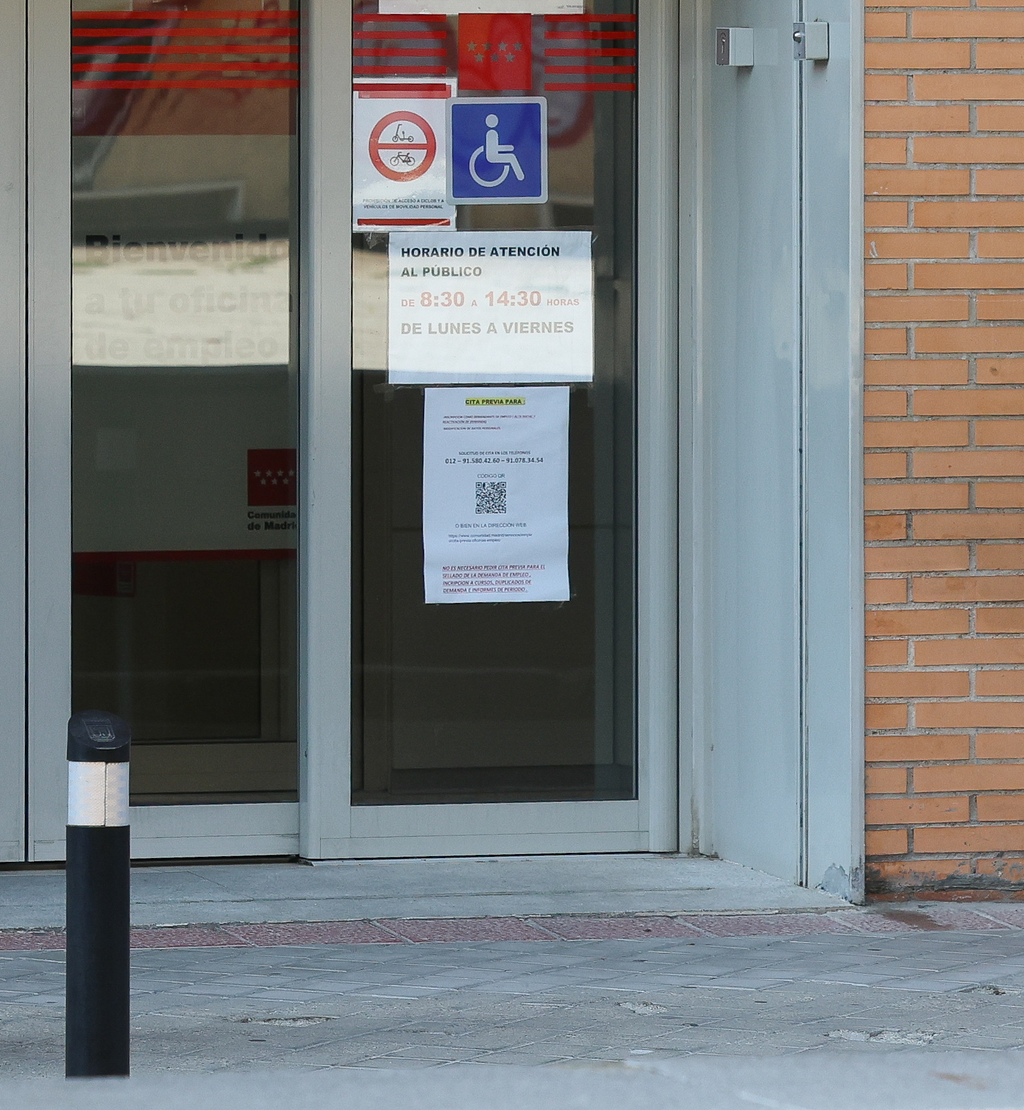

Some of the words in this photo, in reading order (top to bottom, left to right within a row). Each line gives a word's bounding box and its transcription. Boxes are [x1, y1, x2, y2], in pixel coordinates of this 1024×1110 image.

[400, 247, 464, 258] HORARIO
[468, 246, 486, 257] DE
[489, 244, 560, 257] ATENCIÓN
[400, 267, 418, 277] AL
[422, 264, 482, 277] PÚBLICO
[85, 292, 105, 315] a
[401, 299, 415, 307] DE
[420, 291, 465, 307] 8:30
[471, 299, 477, 307] A
[485, 290, 542, 307] 14:30
[546, 298, 580, 306] HORAS
[400, 322, 422, 335] DE
[428, 322, 482, 334] LUNES
[486, 322, 498, 334] A
[503, 321, 574, 334] VIERNES
[85, 332, 130, 361] de
[143, 331, 279, 365] empleo
[247, 510, 296, 519] Comunida
[247, 521, 261, 530] de
[264, 521, 297, 530] Madri
